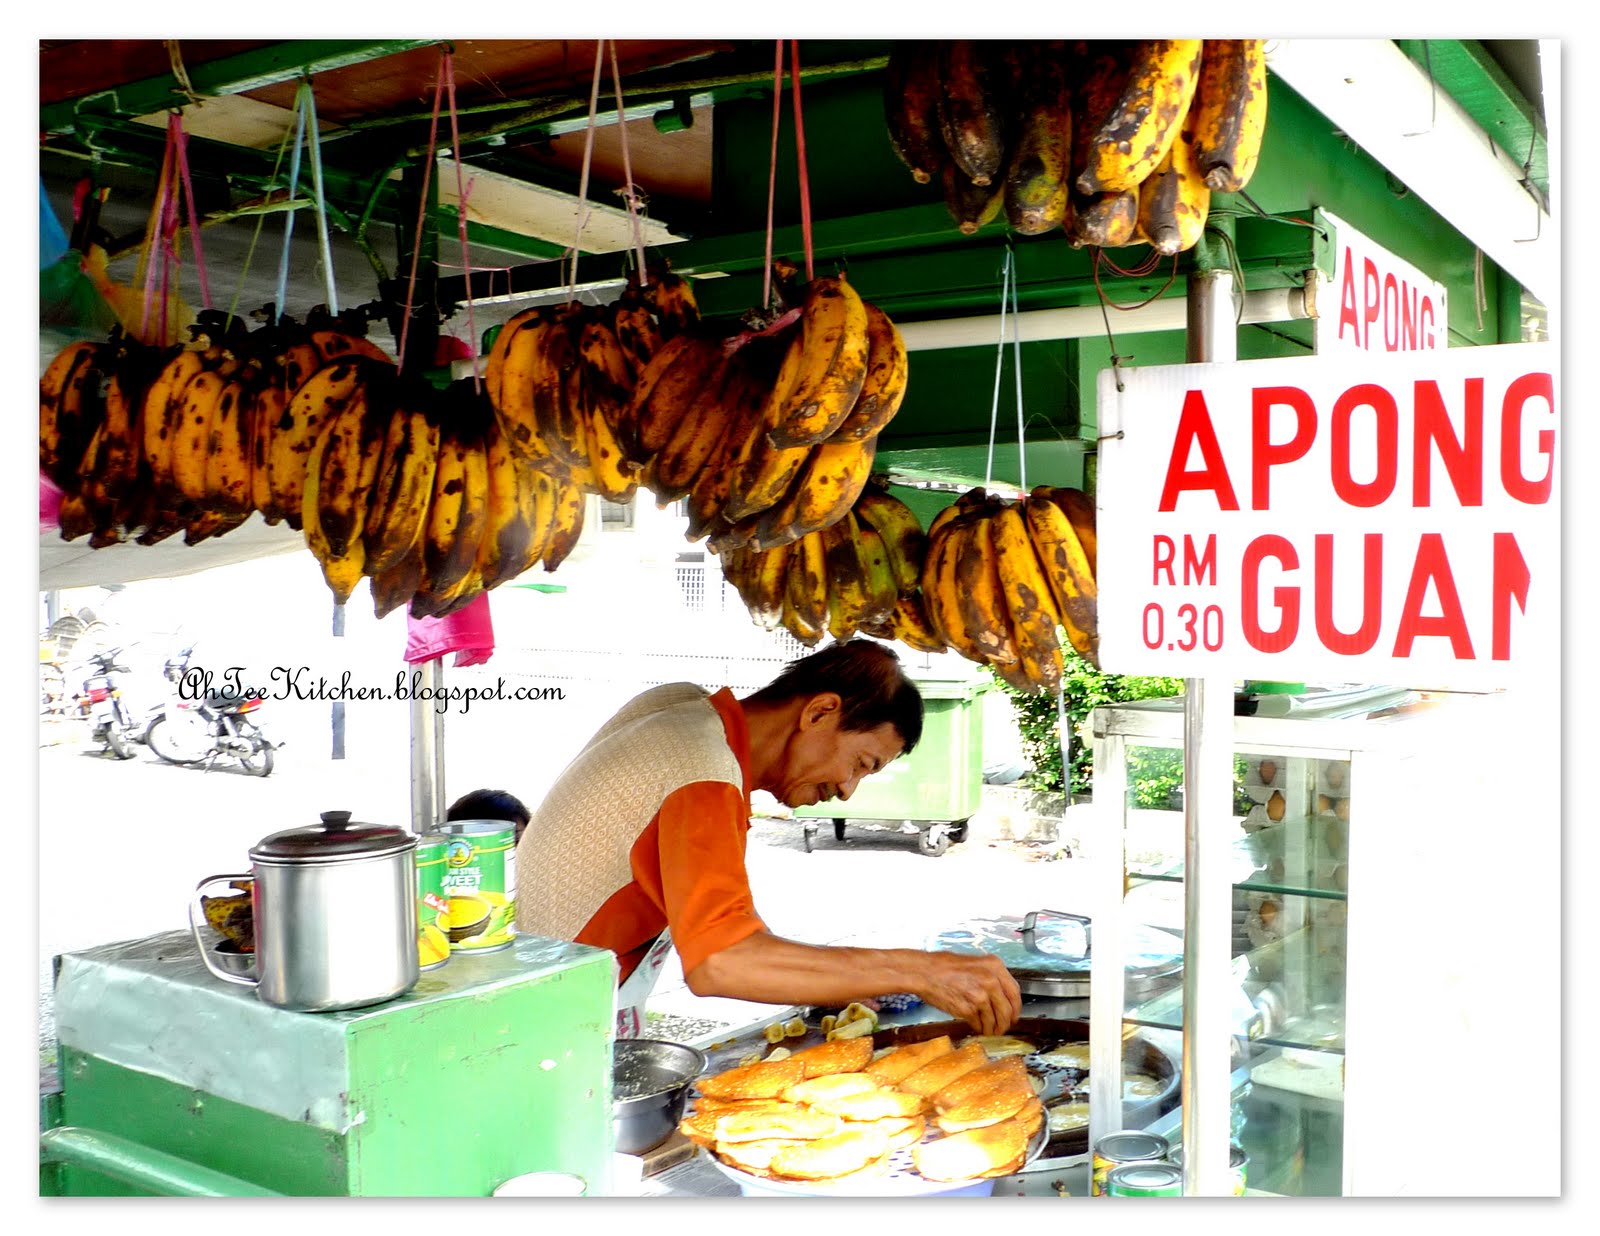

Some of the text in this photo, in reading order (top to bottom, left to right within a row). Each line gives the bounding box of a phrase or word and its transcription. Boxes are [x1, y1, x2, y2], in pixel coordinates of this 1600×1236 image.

[1338, 246, 1435, 352] APONG
[1157, 371, 1556, 513] APONG
[1152, 533, 1217, 587] RM
[1142, 602, 1224, 653] 0.30
